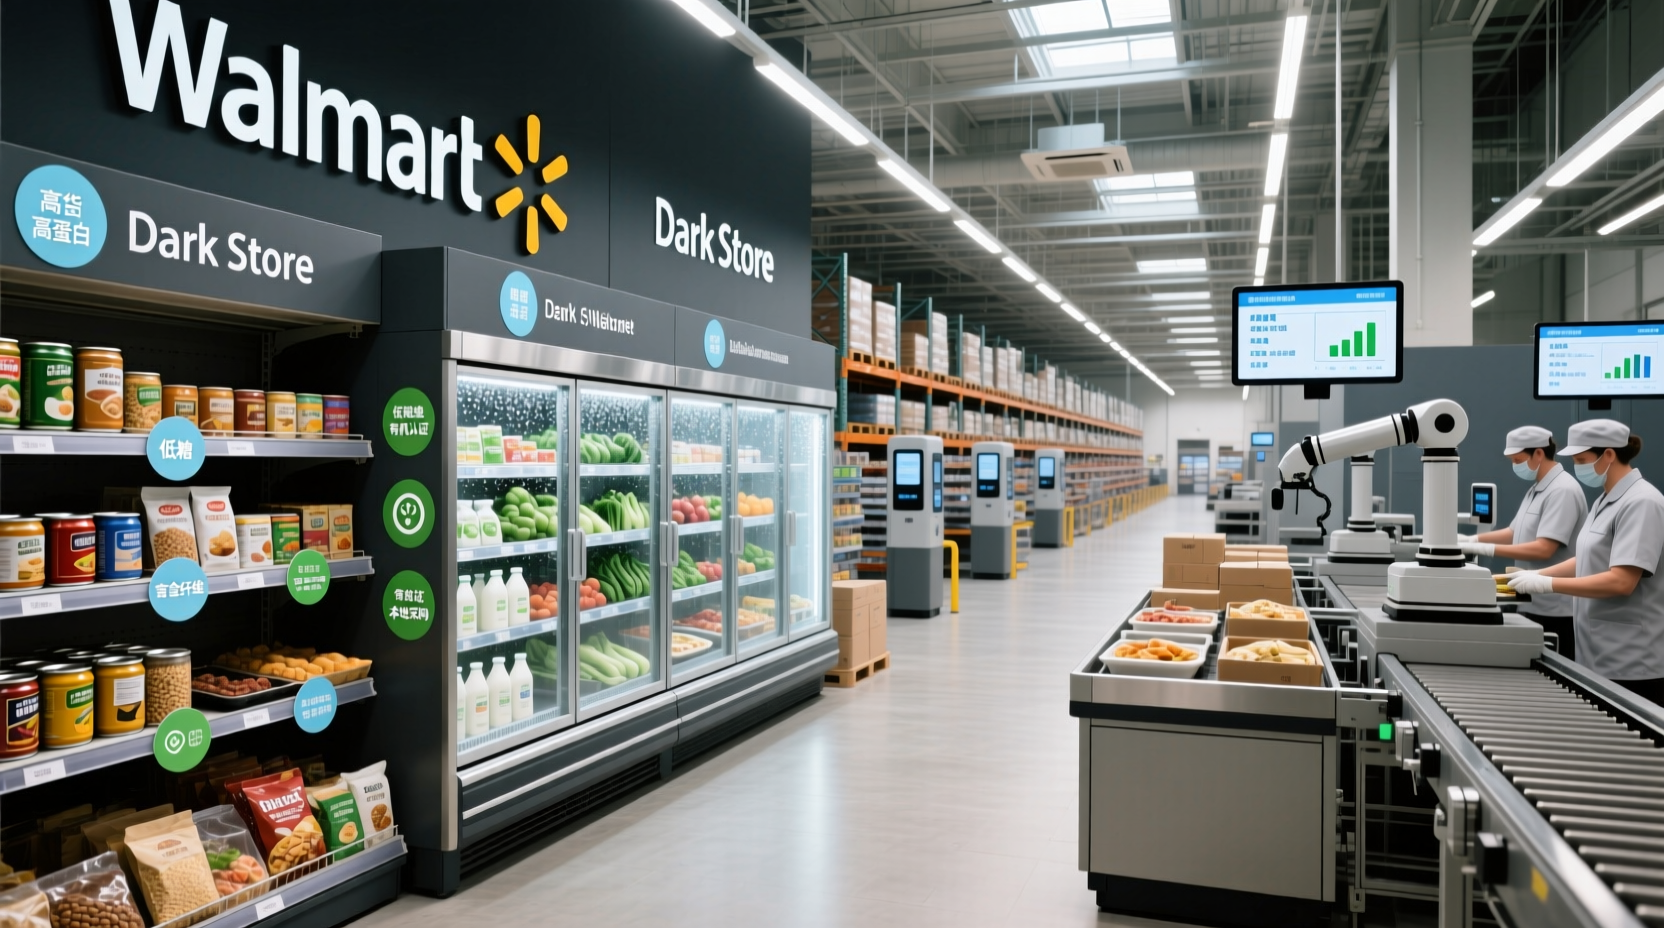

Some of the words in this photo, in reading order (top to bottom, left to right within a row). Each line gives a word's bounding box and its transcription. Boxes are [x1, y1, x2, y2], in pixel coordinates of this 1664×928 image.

[109, 0, 483, 212] Walmart
[129, 210, 219, 267] Dark
[227, 232, 314, 284] Store
[656, 196, 715, 264] Dark
[718, 222, 775, 283] Store
